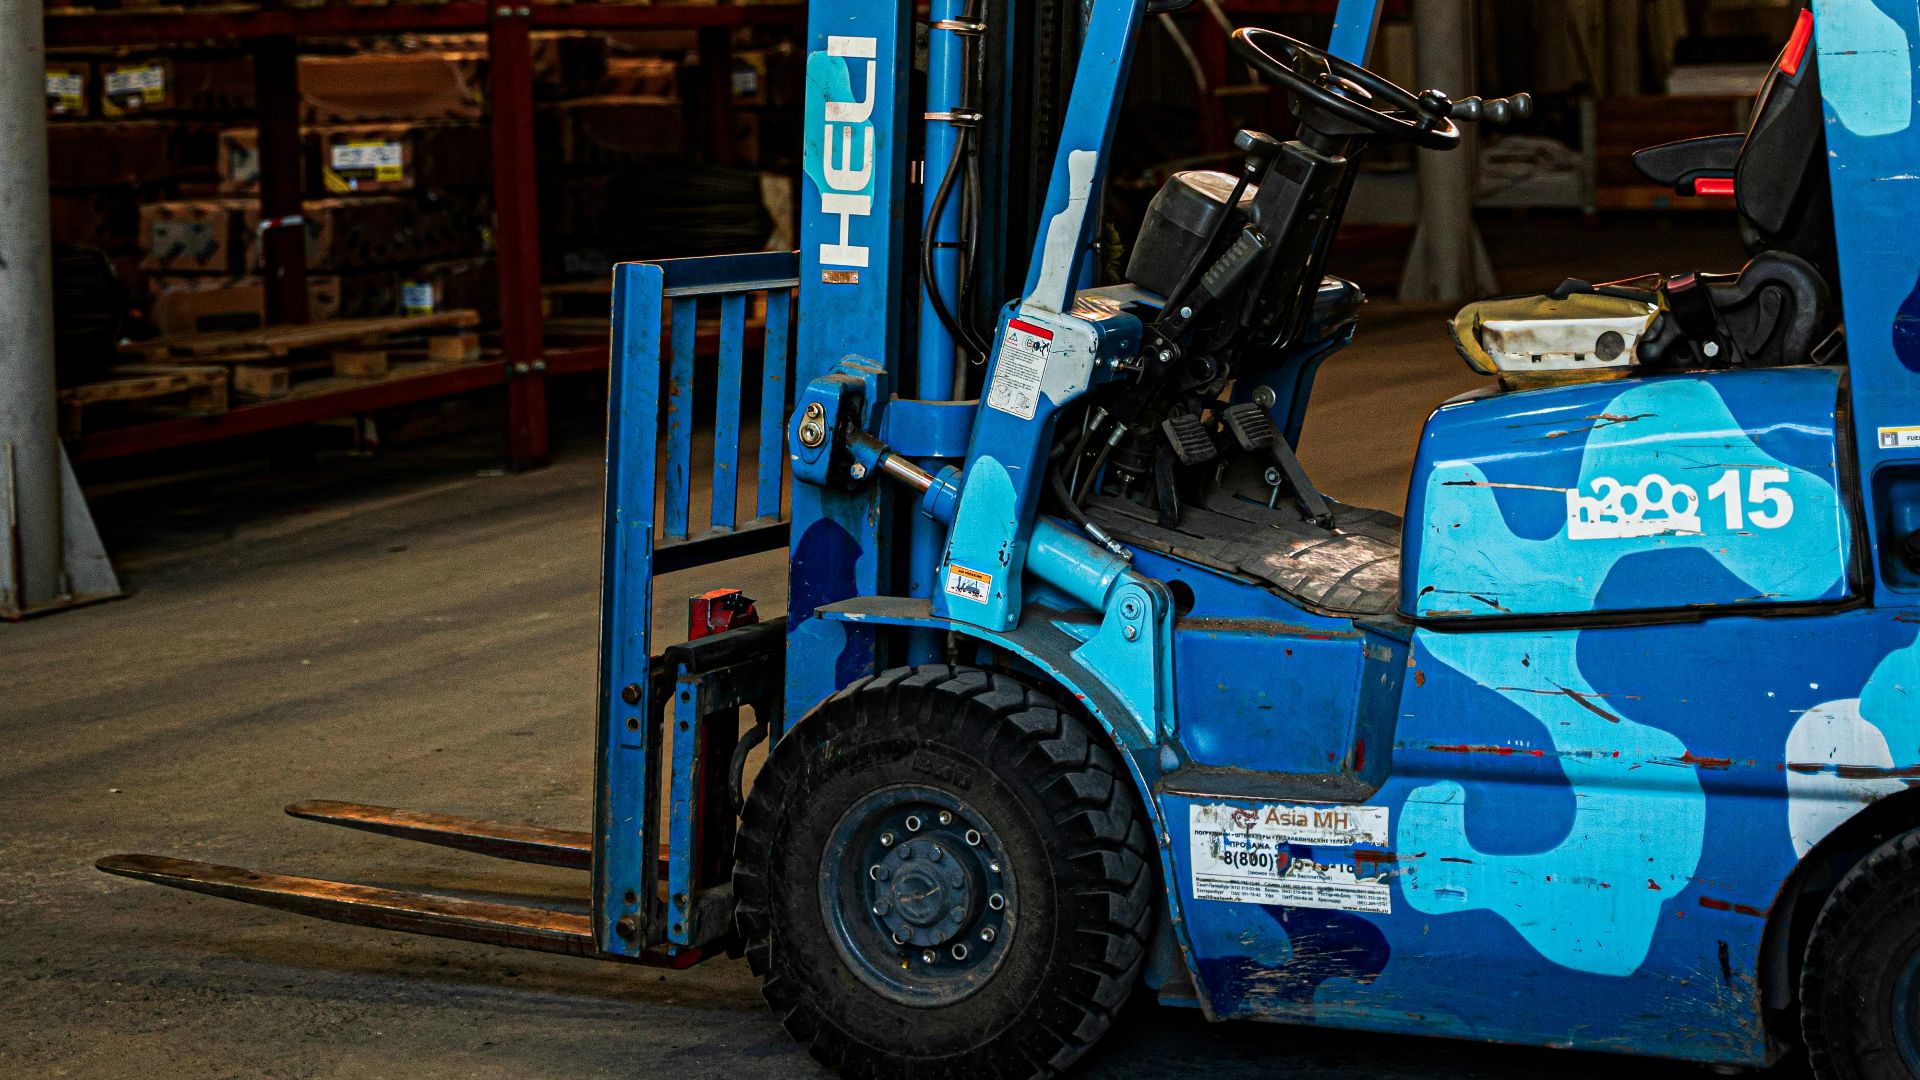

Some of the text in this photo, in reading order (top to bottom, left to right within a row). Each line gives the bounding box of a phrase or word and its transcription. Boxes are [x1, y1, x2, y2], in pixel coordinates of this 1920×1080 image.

[819, 35, 877, 267] HELI
[1708, 469, 1794, 530] 15
[1264, 808, 1348, 830] Asia MH
[1230, 841, 1270, 850] ПРОАЖА
